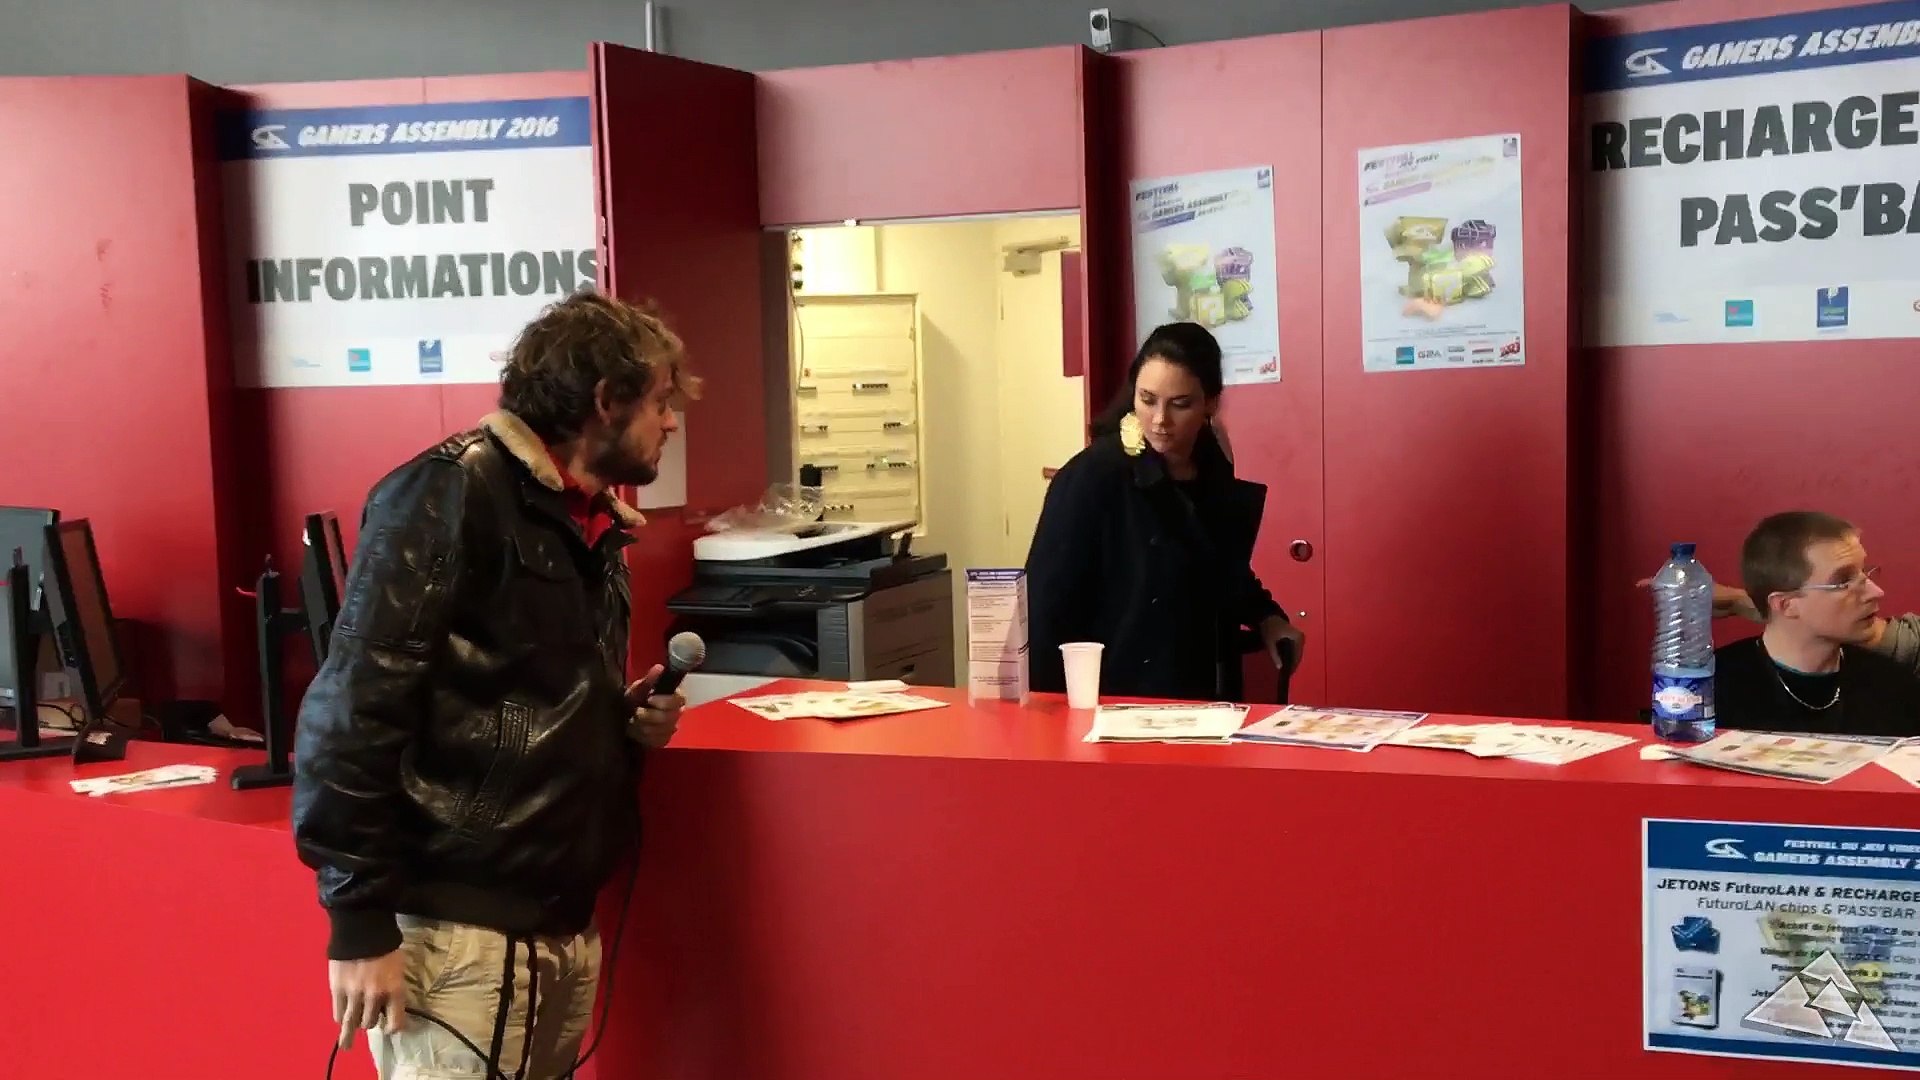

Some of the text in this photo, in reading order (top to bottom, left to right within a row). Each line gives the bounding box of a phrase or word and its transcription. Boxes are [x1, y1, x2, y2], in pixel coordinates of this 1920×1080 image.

[1682, 35, 1797, 69] GAMERS
[298, 123, 388, 146] GAMERS
[390, 118, 506, 143] ASSEMBLY
[506, 116, 560, 138] 2016
[348, 178, 494, 227] POINT
[247, 249, 598, 305] INFORMATIONS
[1753, 851, 1820, 865] GAMERS
[1823, 854, 1910, 869] ASSEMBLY
[1657, 878, 1720, 892] JETONS
[1725, 882, 1810, 897] FuturoLAN
[1815, 886, 1825, 897] &
[1697, 898, 1916, 919] FuturoLAN chips & PASS'BAR
